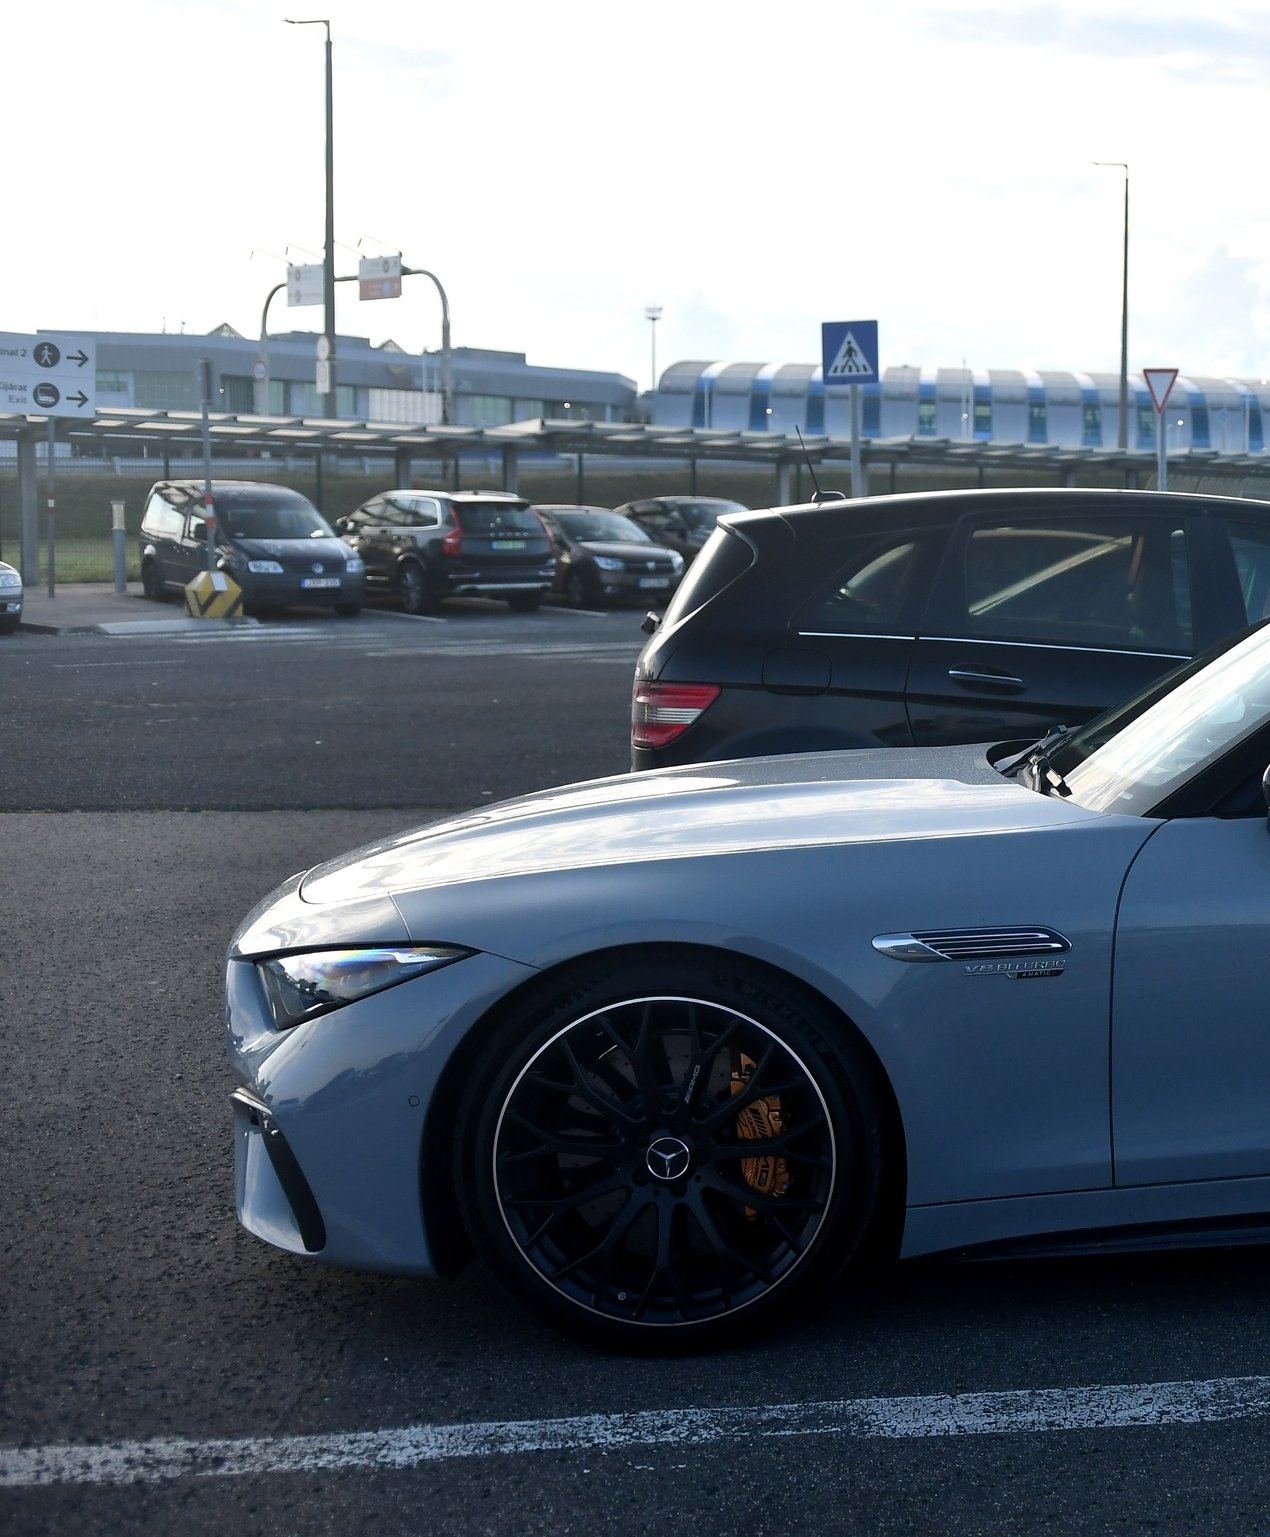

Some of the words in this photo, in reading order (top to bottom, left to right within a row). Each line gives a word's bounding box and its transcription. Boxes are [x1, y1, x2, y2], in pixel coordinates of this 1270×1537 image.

[20, 348, 27, 358] 2
[8, 394, 27, 404] Exit
[997, 959, 1067, 972] BITURBO
[736, 982, 831, 1055] MICHELIN
